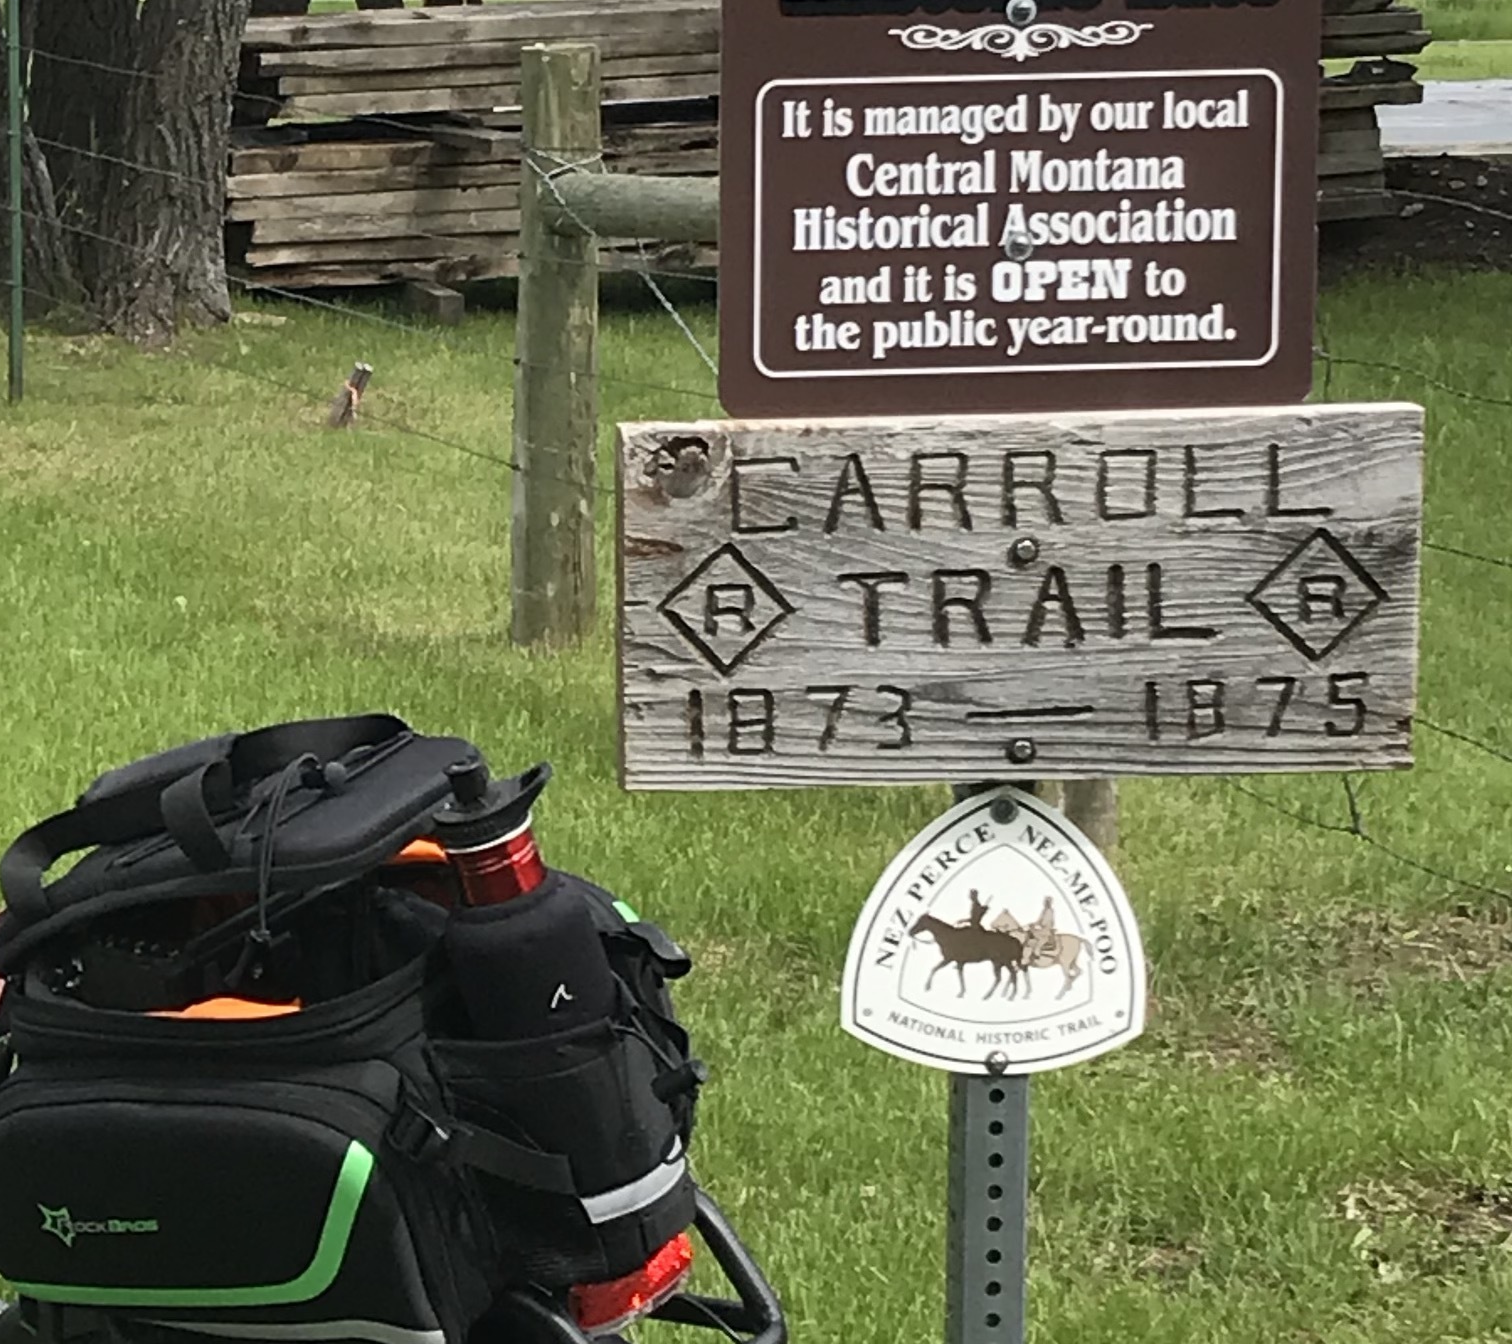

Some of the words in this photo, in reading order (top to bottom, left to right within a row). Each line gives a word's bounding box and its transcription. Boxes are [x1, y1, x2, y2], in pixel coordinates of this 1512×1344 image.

[783, 101, 811, 137] It
[823, 98, 853, 136] is
[864, 95, 1027, 144] managed
[1039, 94, 1082, 142] by
[1091, 102, 1154, 130] our
[1163, 90, 1248, 128] local
[847, 150, 996, 196] Central
[1010, 149, 1185, 192] Montana
[793, 203, 989, 250] Historical
[999, 198, 1236, 250] Association
[820, 266, 890, 304] and
[904, 266, 932, 302] it
[944, 265, 976, 301] is
[992, 259, 1131, 302] OPEN
[1146, 262, 1185, 296] to
[795, 313, 860, 350] the
[873, 310, 997, 358] public
[1007, 304, 1236, 355] year-round.
[730, 441, 1333, 535] CARROLL
[837, 562, 1222, 648] TRAIL
[686, 684, 913, 758] 1873
[1142, 672, 1369, 741] 1875
[875, 907, 914, 970] NEZ
[907, 822, 997, 902] PERCE
[1017, 824, 1117, 976] NEE-ME-POO
[887, 1010, 966, 1043] NATIONAL
[976, 1028, 1051, 1044] HISTORIC
[1058, 1015, 1103, 1036] TRAIL
